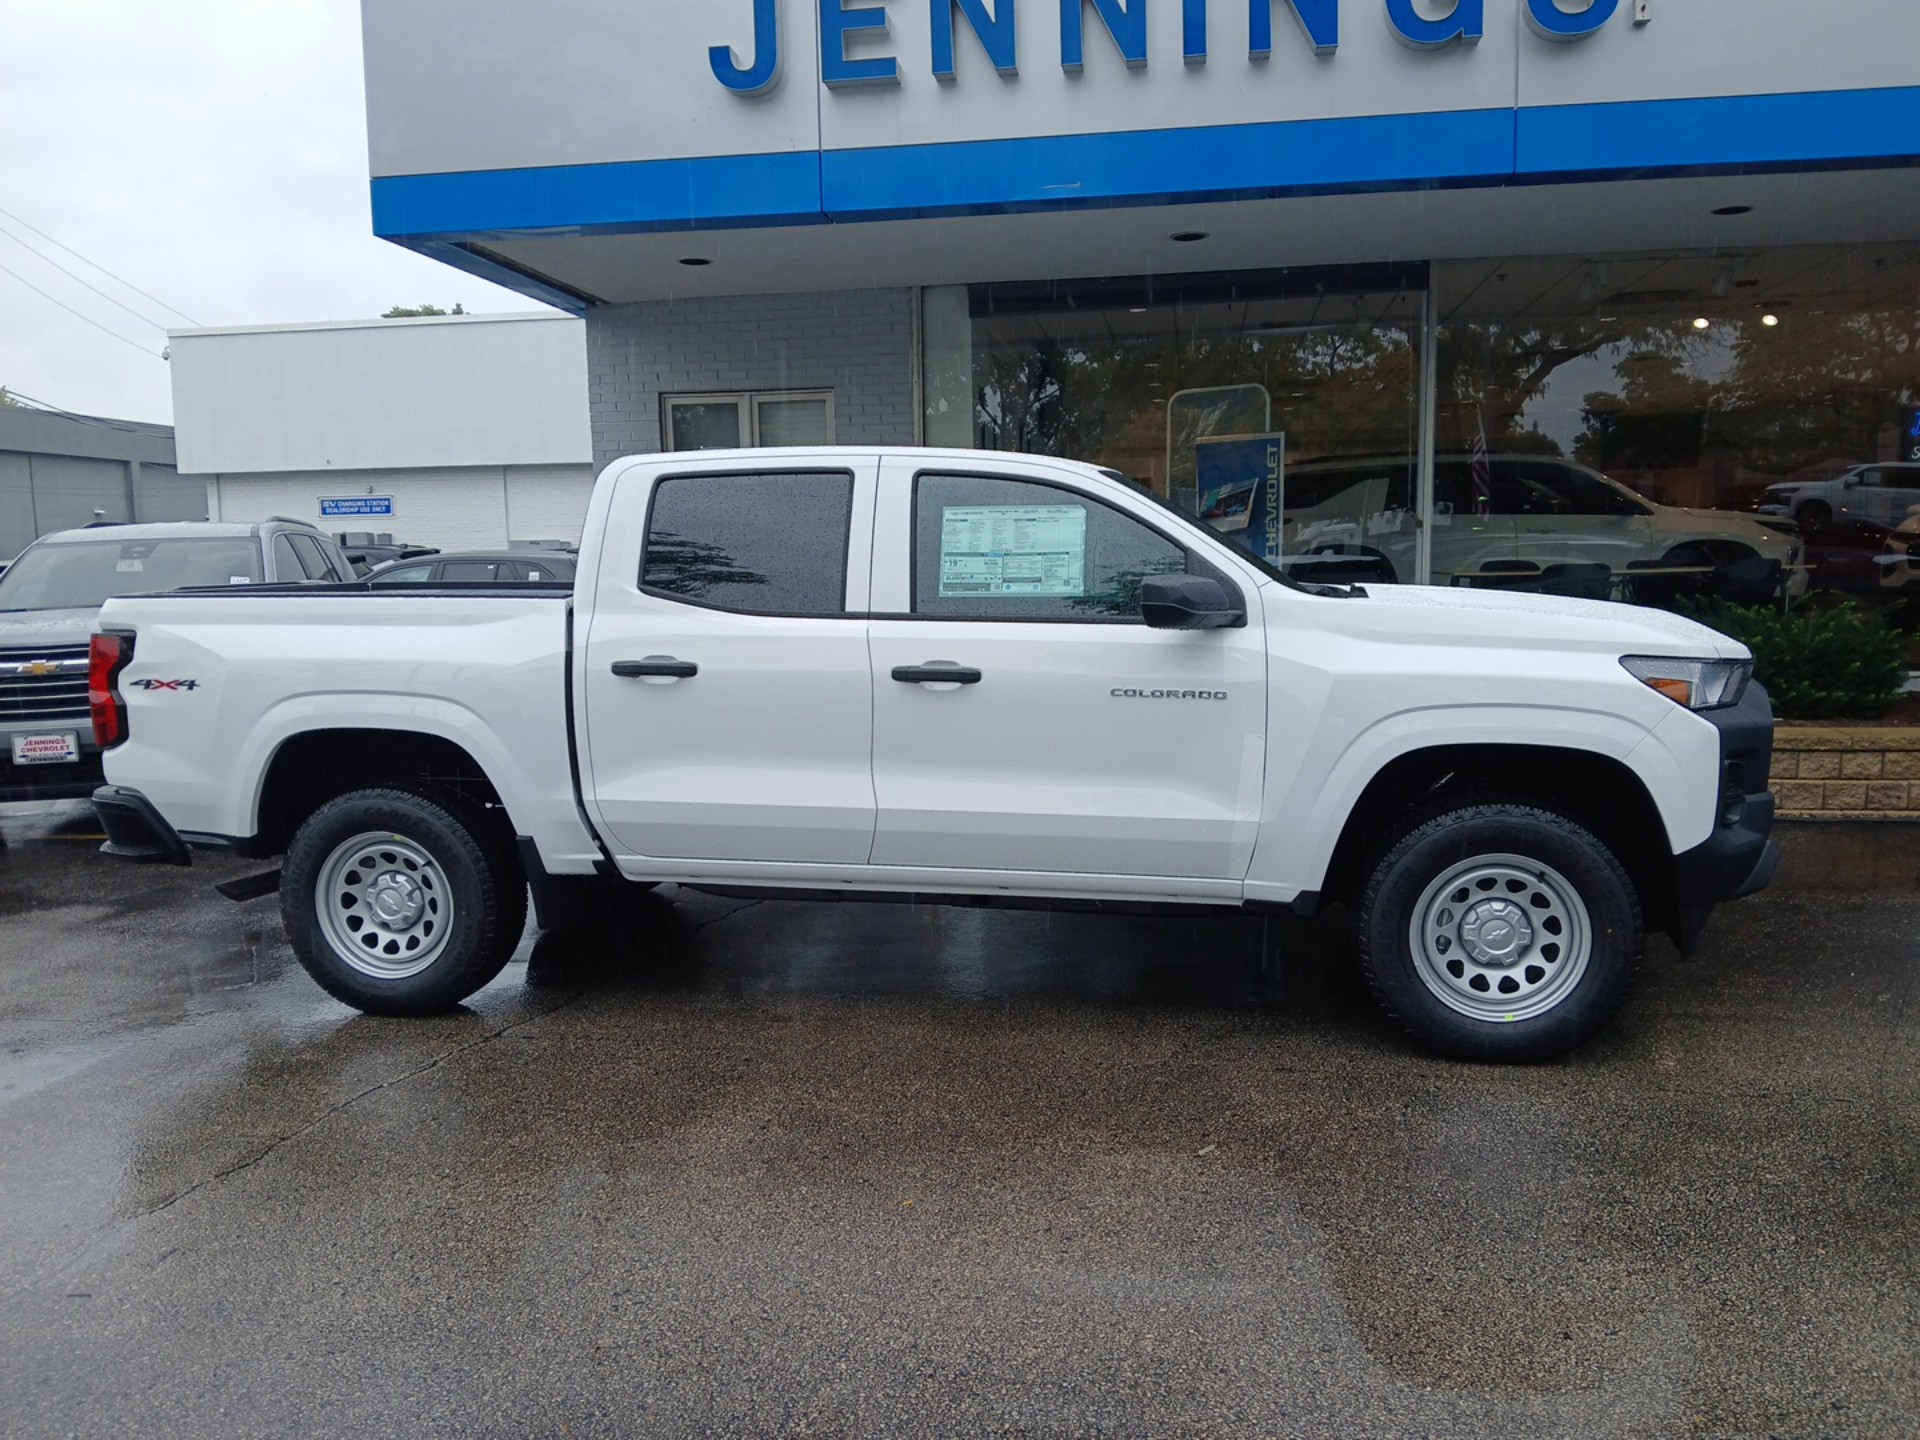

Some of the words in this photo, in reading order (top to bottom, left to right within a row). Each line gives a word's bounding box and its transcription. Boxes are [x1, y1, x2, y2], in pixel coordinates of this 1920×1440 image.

[708, 0, 1620, 92] JENN
[1265, 444, 1279, 560] CHEVROLET
[1110, 688, 1228, 700] COLORADO
[21, 744, 70, 753] CHEVROLET
[23, 738, 66, 747] JENNINGS
